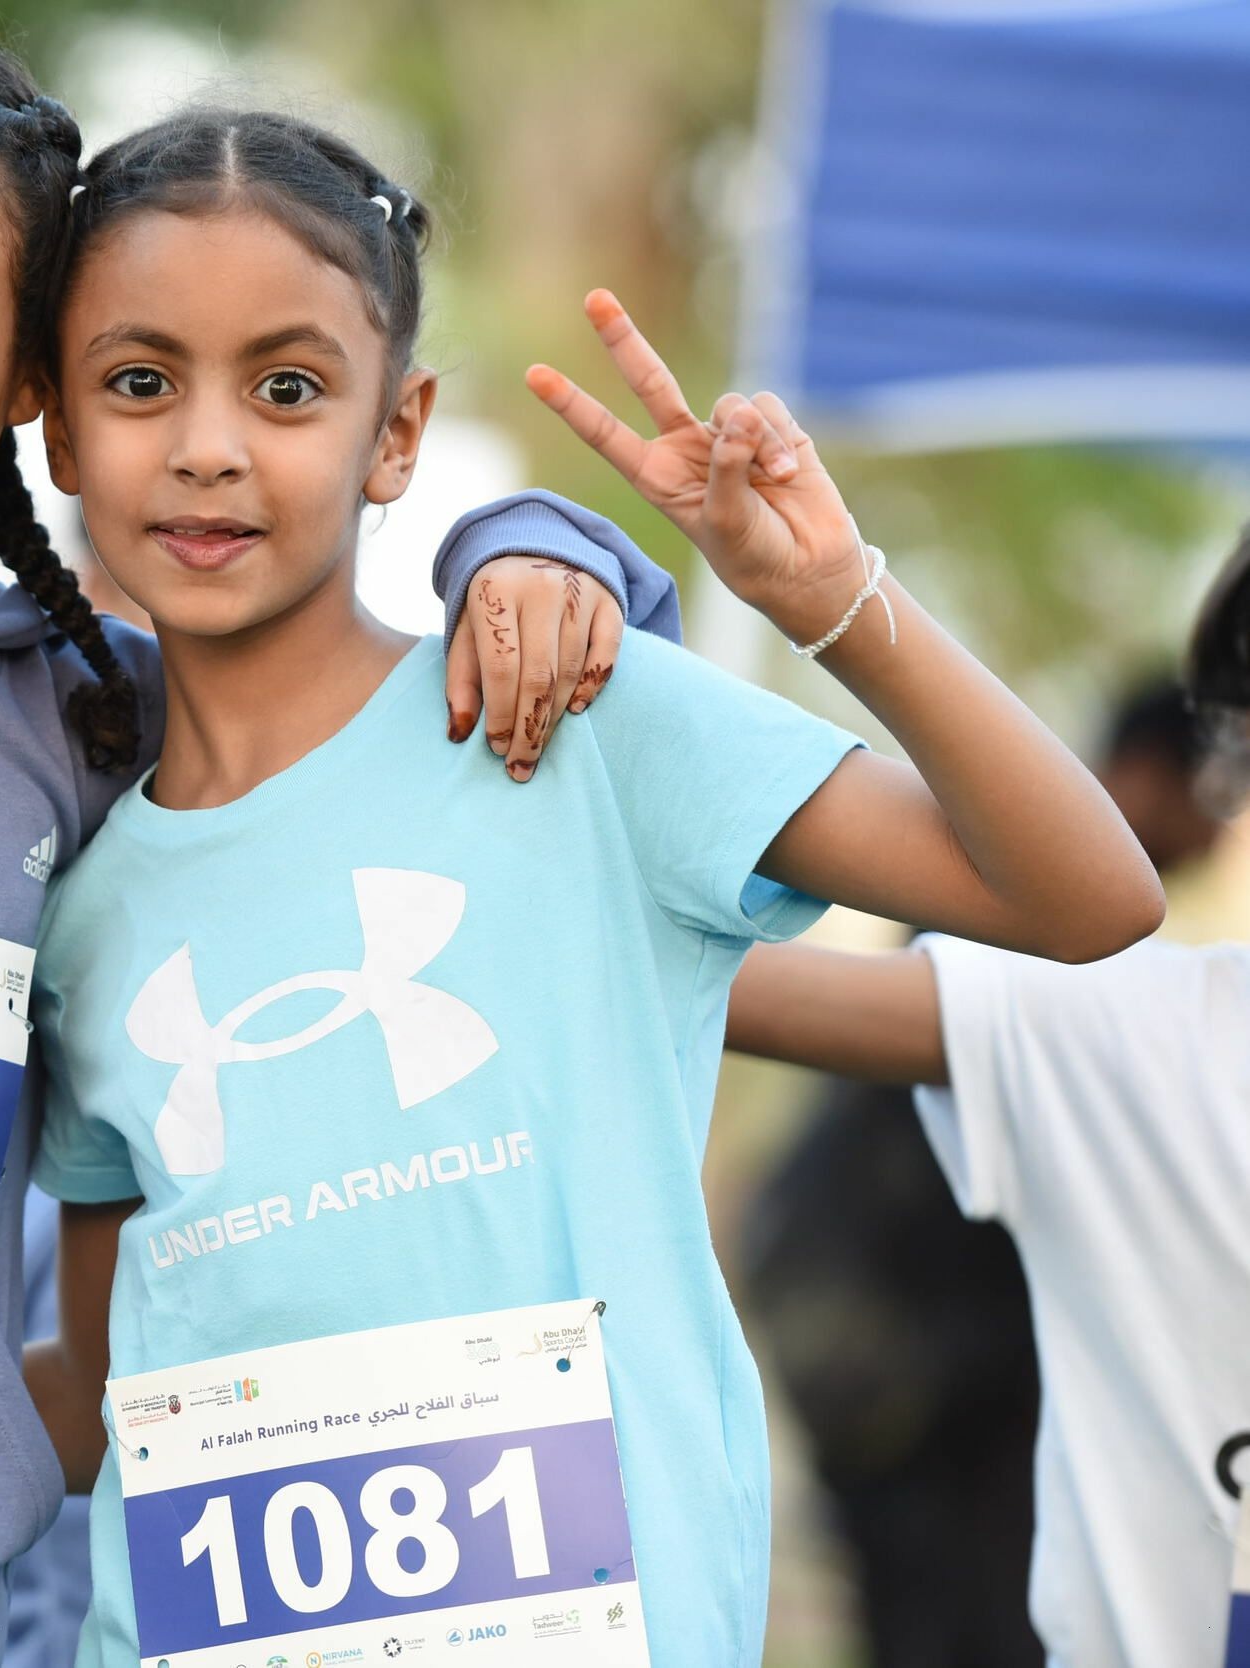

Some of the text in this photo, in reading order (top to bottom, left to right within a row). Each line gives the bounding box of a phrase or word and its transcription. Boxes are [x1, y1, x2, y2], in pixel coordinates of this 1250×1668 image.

[147, 1130, 536, 1270] UNDER ARMOUR
[542, 1330, 560, 1339] Abu
[367, 1391, 500, 1428] سباق الفلاح للجري
[200, 1412, 361, 1451] Al Falah Running Race
[180, 1445, 551, 1627] 1081
[467, 1624, 507, 1642] JAKO
[322, 1648, 364, 1660] NIRVANA
